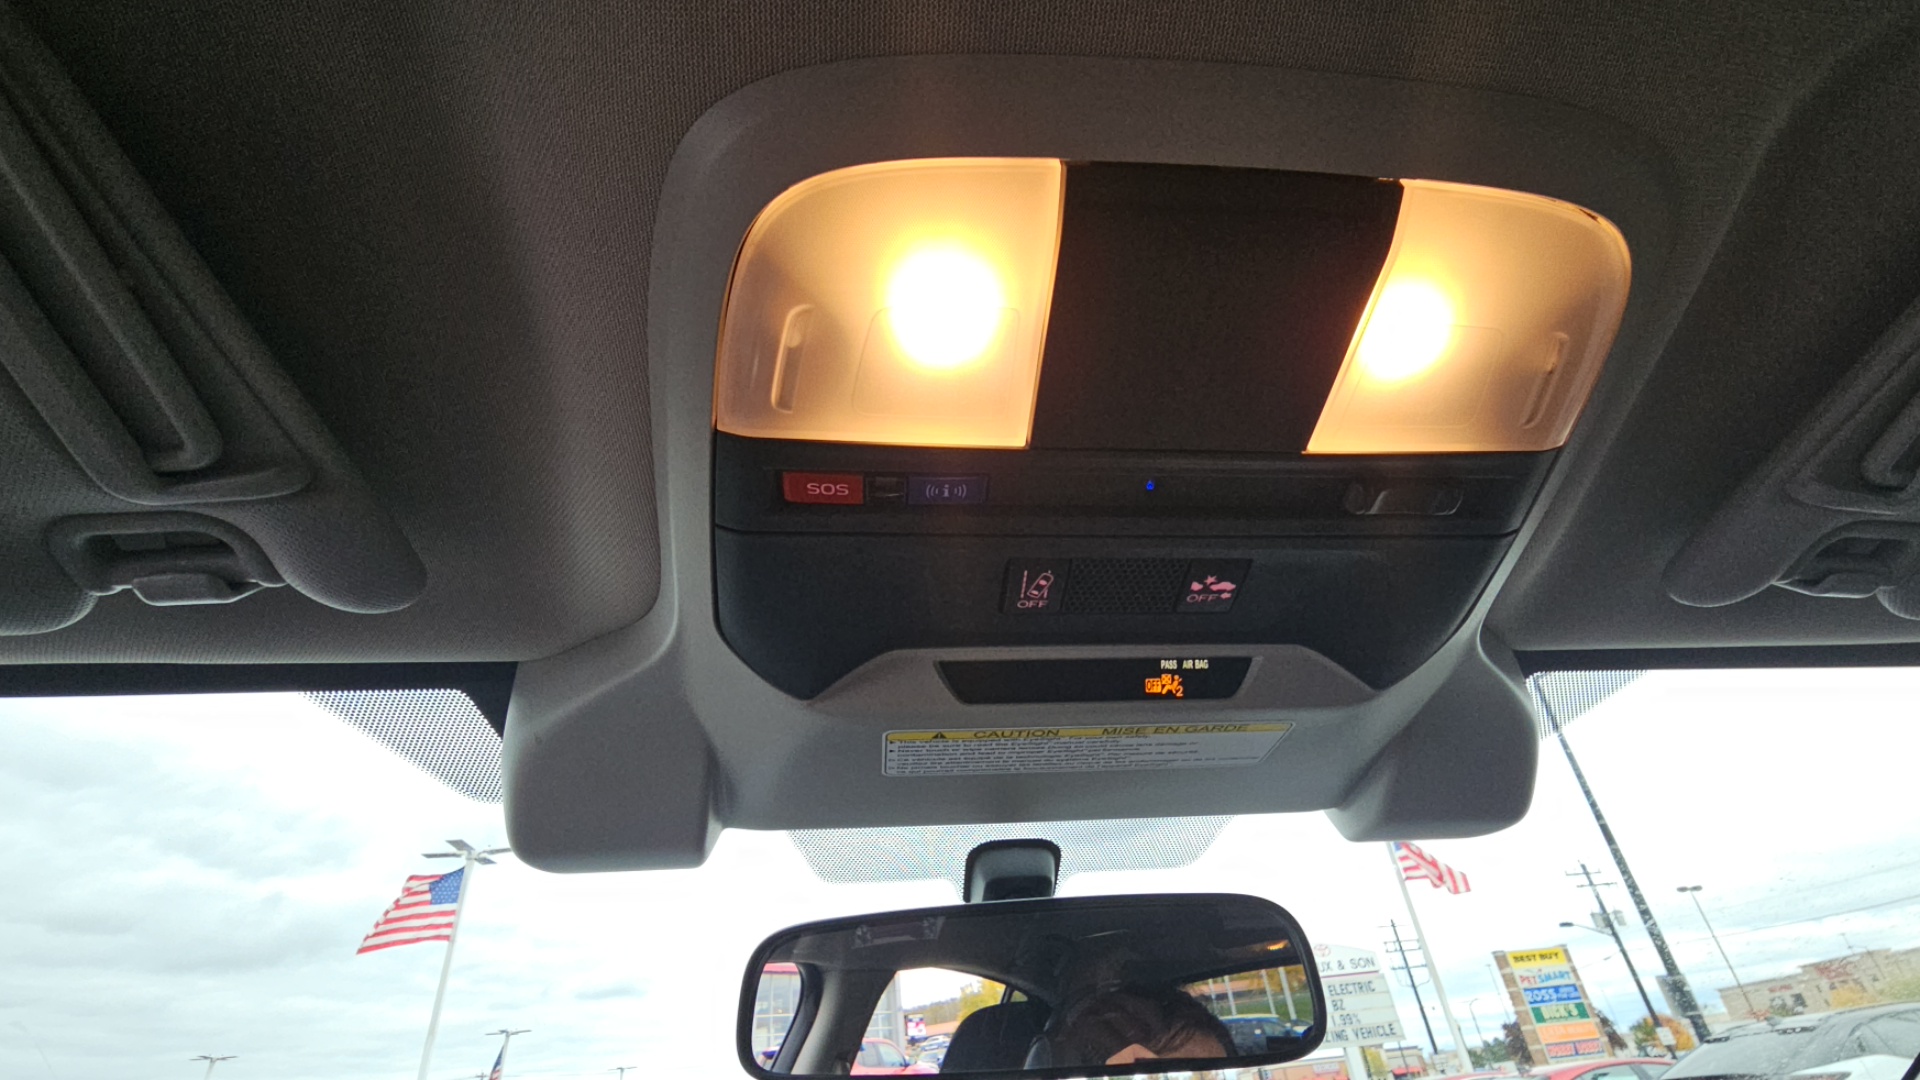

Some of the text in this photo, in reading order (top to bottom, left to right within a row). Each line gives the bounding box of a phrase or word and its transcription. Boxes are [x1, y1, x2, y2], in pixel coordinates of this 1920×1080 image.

[806, 482, 849, 496] SOS
[1017, 599, 1048, 609] OFF
[1186, 593, 1218, 604] OFF
[1160, 659, 1209, 670] PASS AIR BAG
[1146, 679, 1161, 692] OFF
[973, 729, 1060, 739] CAUTION
[1101, 724, 1249, 736] MISE EN GARDE
[1512, 952, 1559, 963] BEST BUY
[1320, 962, 1333, 973] UX
[1349, 958, 1375, 969] SON
[1328, 981, 1375, 995] ELECTRIC
[1325, 1024, 1396, 1042] ZING VEHICLE
